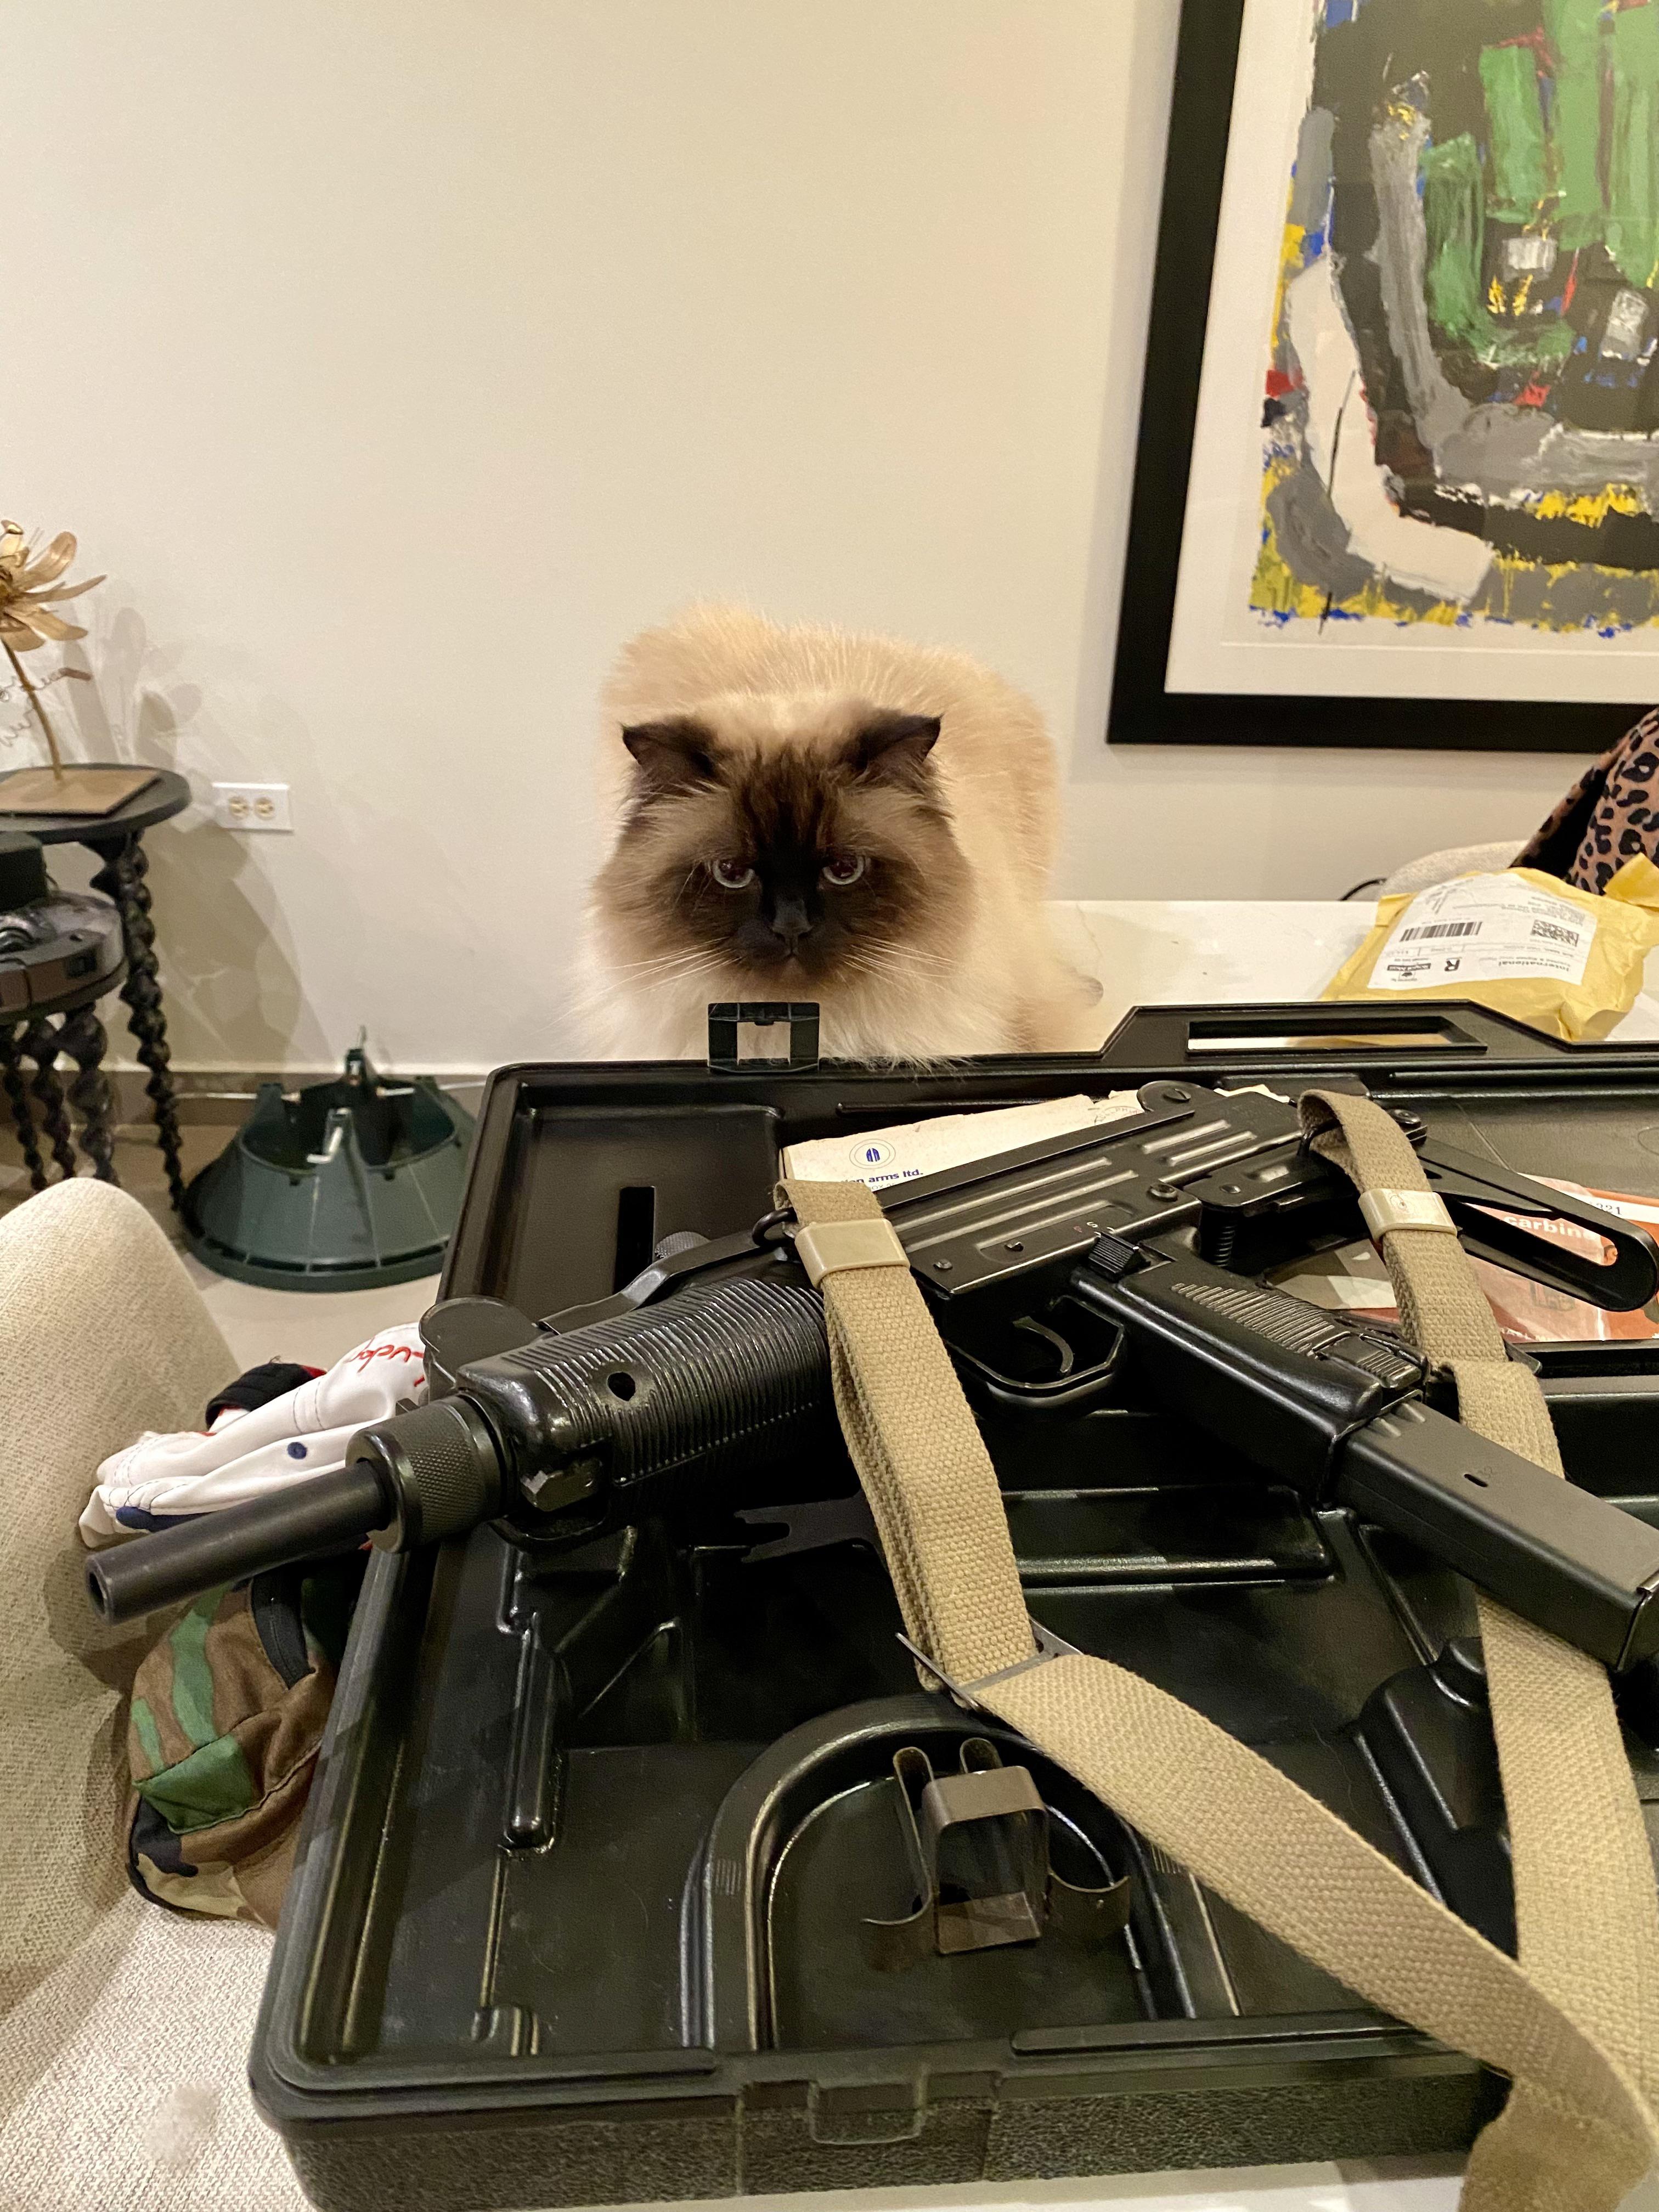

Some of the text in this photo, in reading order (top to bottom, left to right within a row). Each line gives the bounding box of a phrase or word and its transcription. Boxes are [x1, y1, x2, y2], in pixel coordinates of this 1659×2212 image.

[1444, 959, 1460, 972] R
[1498, 961, 1570, 972] International
[868, 1173, 900, 1183] arms
[902, 1169, 923, 1177] ltd.
[343, 1336, 424, 1374] ucky
